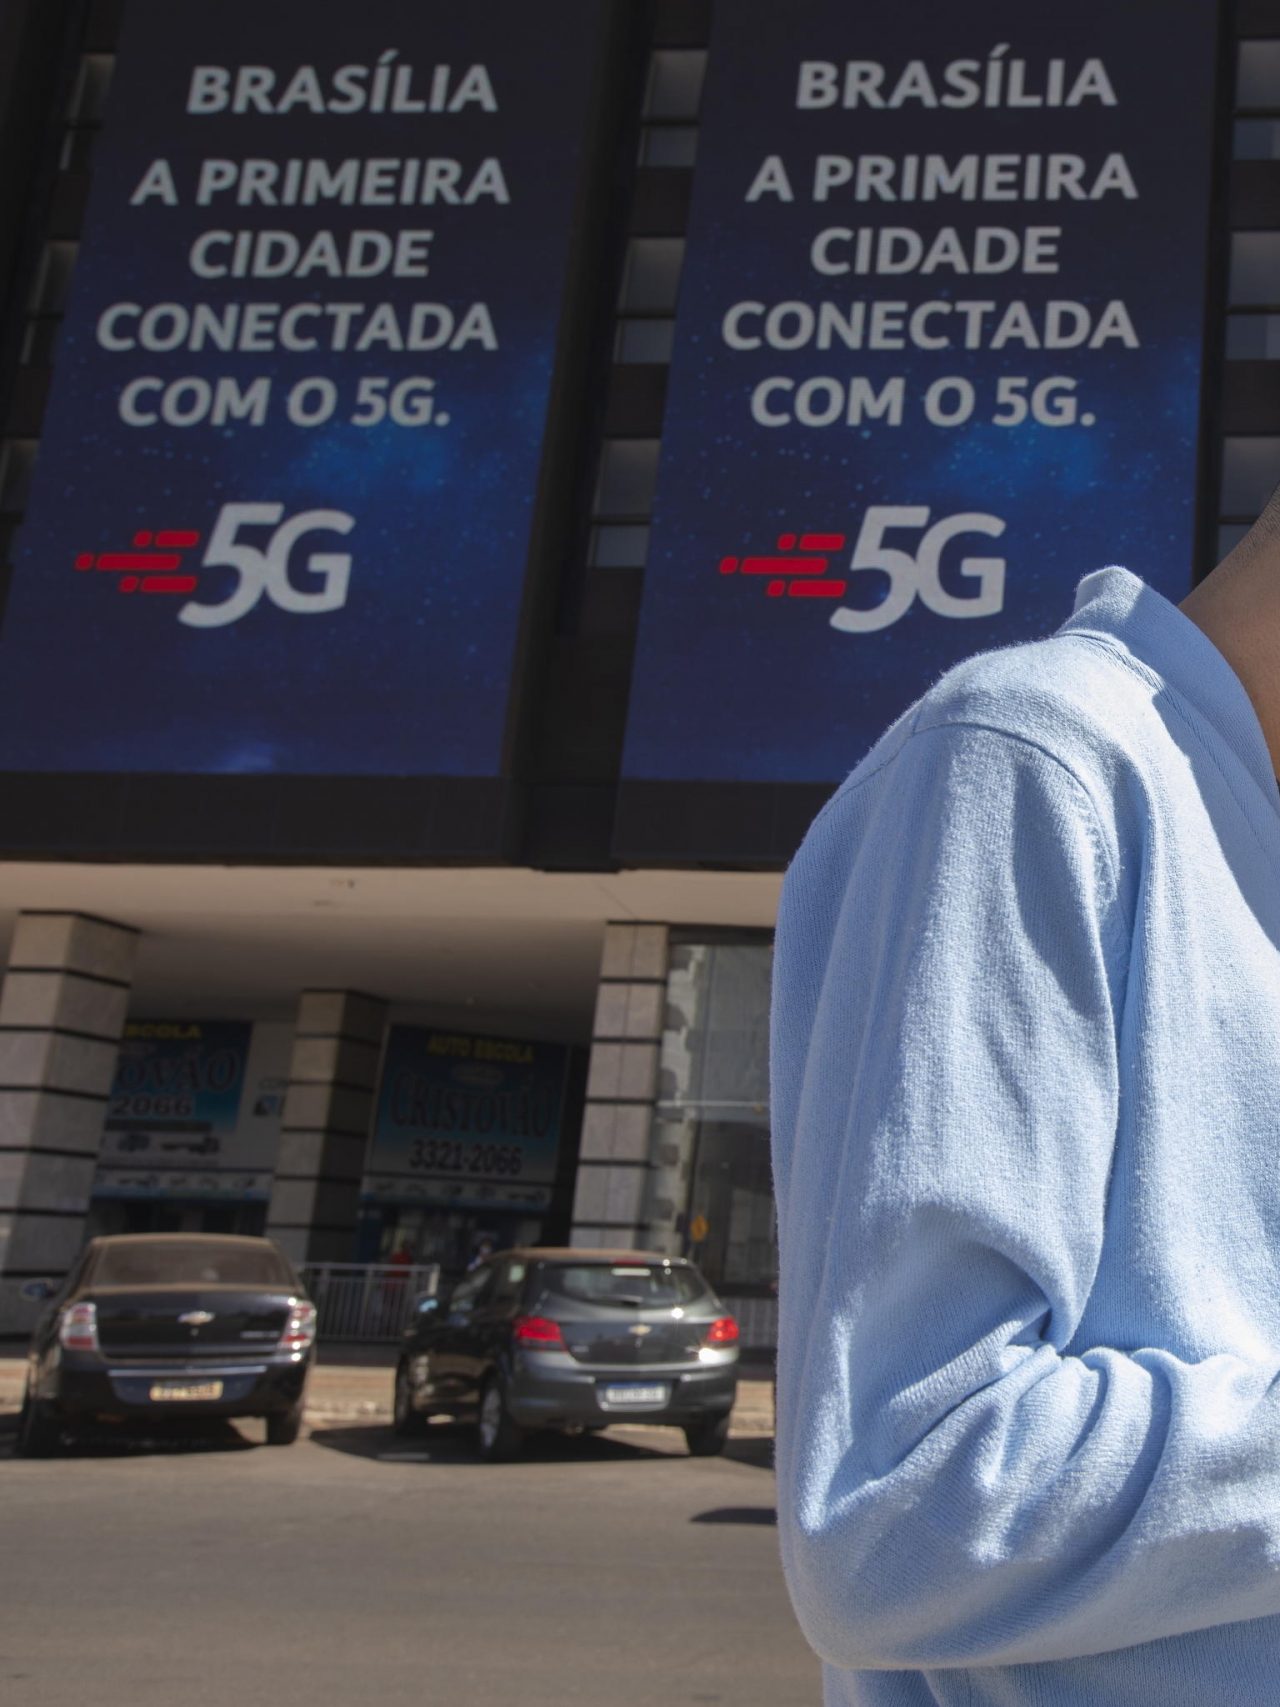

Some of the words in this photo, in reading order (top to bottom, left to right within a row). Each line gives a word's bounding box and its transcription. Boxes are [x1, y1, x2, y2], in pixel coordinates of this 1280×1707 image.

[187, 49, 497, 113] BRASÍLIA
[796, 43, 1117, 109] BRASÍLIA
[130, 159, 177, 205] A
[197, 158, 509, 205] PRIMEIRA
[745, 155, 793, 202] A
[813, 153, 1138, 201] PRIMEIRA
[190, 230, 433, 278] CIDADE
[811, 226, 1061, 275] CIDADE
[97, 302, 498, 351] CONECTADA
[722, 300, 1140, 350] CONECTADA
[119, 377, 271, 426] COM
[287, 377, 337, 427] O
[351, 376, 449, 426] 5G.
[751, 377, 905, 427] COM
[924, 376, 975, 427] O
[992, 376, 1095, 427] 5G.
[178, 503, 354, 627] 5G
[829, 505, 1006, 633] 5G
